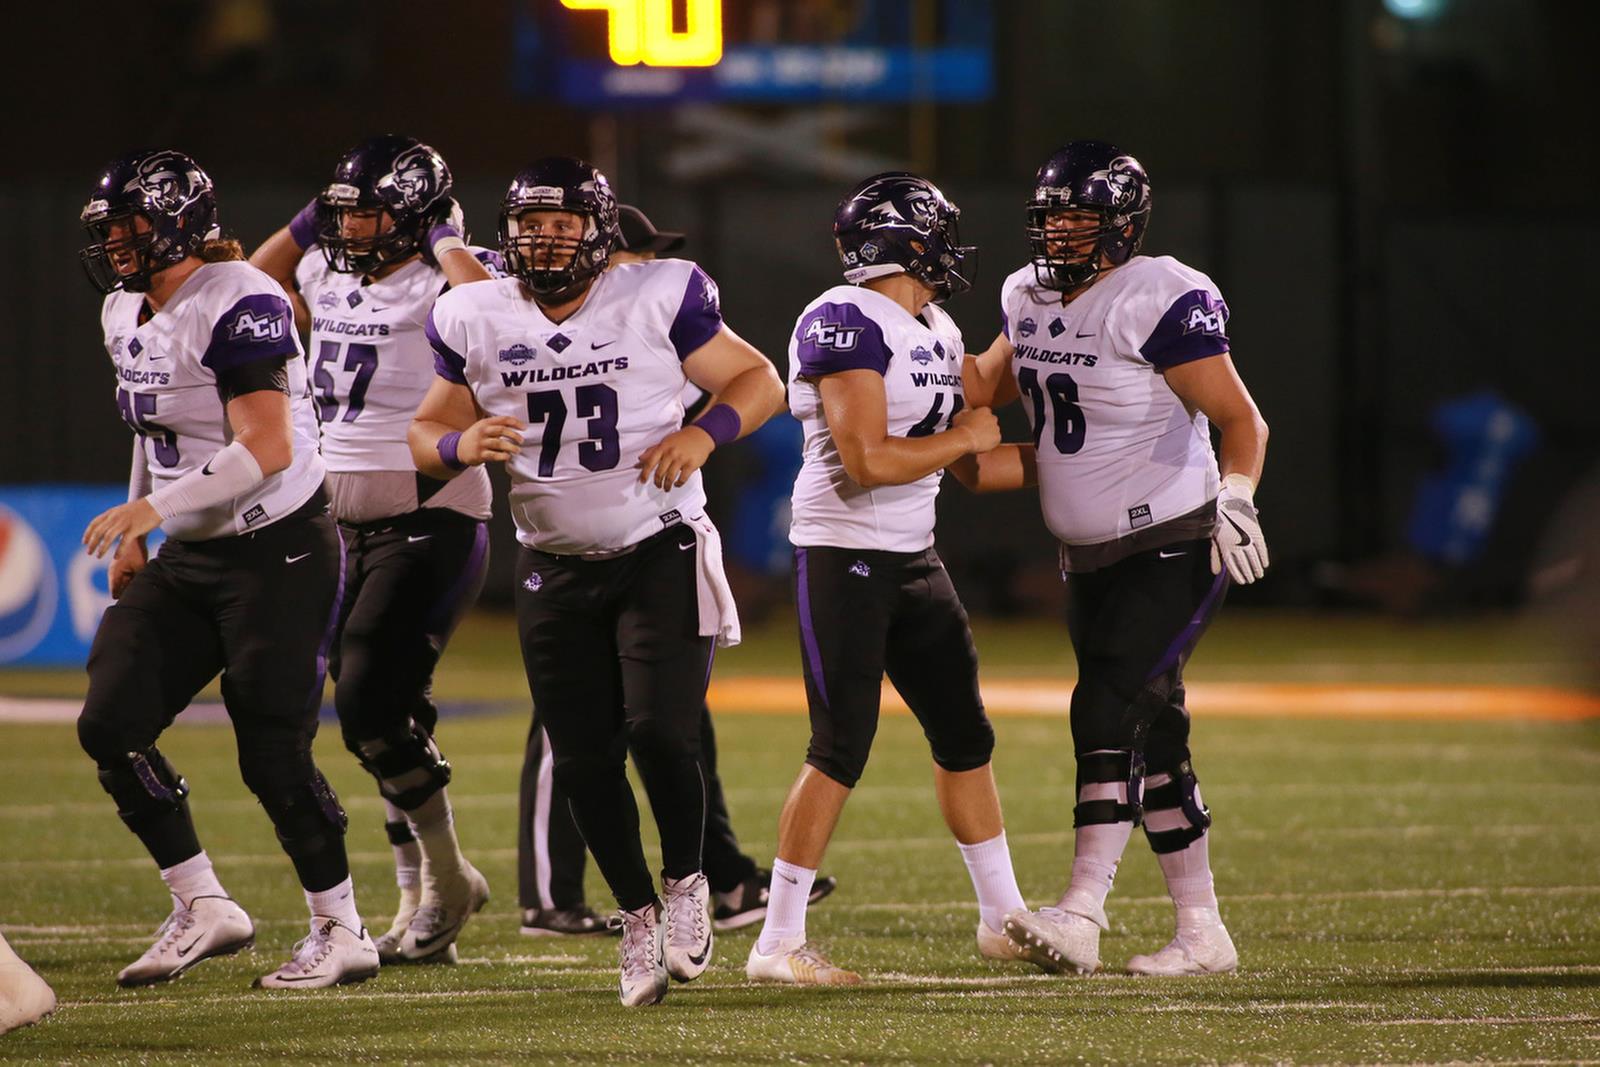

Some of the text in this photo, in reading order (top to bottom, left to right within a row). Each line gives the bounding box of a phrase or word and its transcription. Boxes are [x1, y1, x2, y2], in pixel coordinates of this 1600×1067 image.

[234, 313, 284, 339] ACU
[312, 317, 390, 337] WILDCATS
[805, 319, 856, 348] ACU
[1014, 343, 1098, 367] WILDCATS
[116, 366, 170, 385] LDCATS
[313, 340, 379, 423] 57
[500, 356, 629, 387] WILDCATS
[910, 372, 963, 387] WILDCA
[1018, 366, 1086, 454] 76
[526, 382, 620, 478] 73
